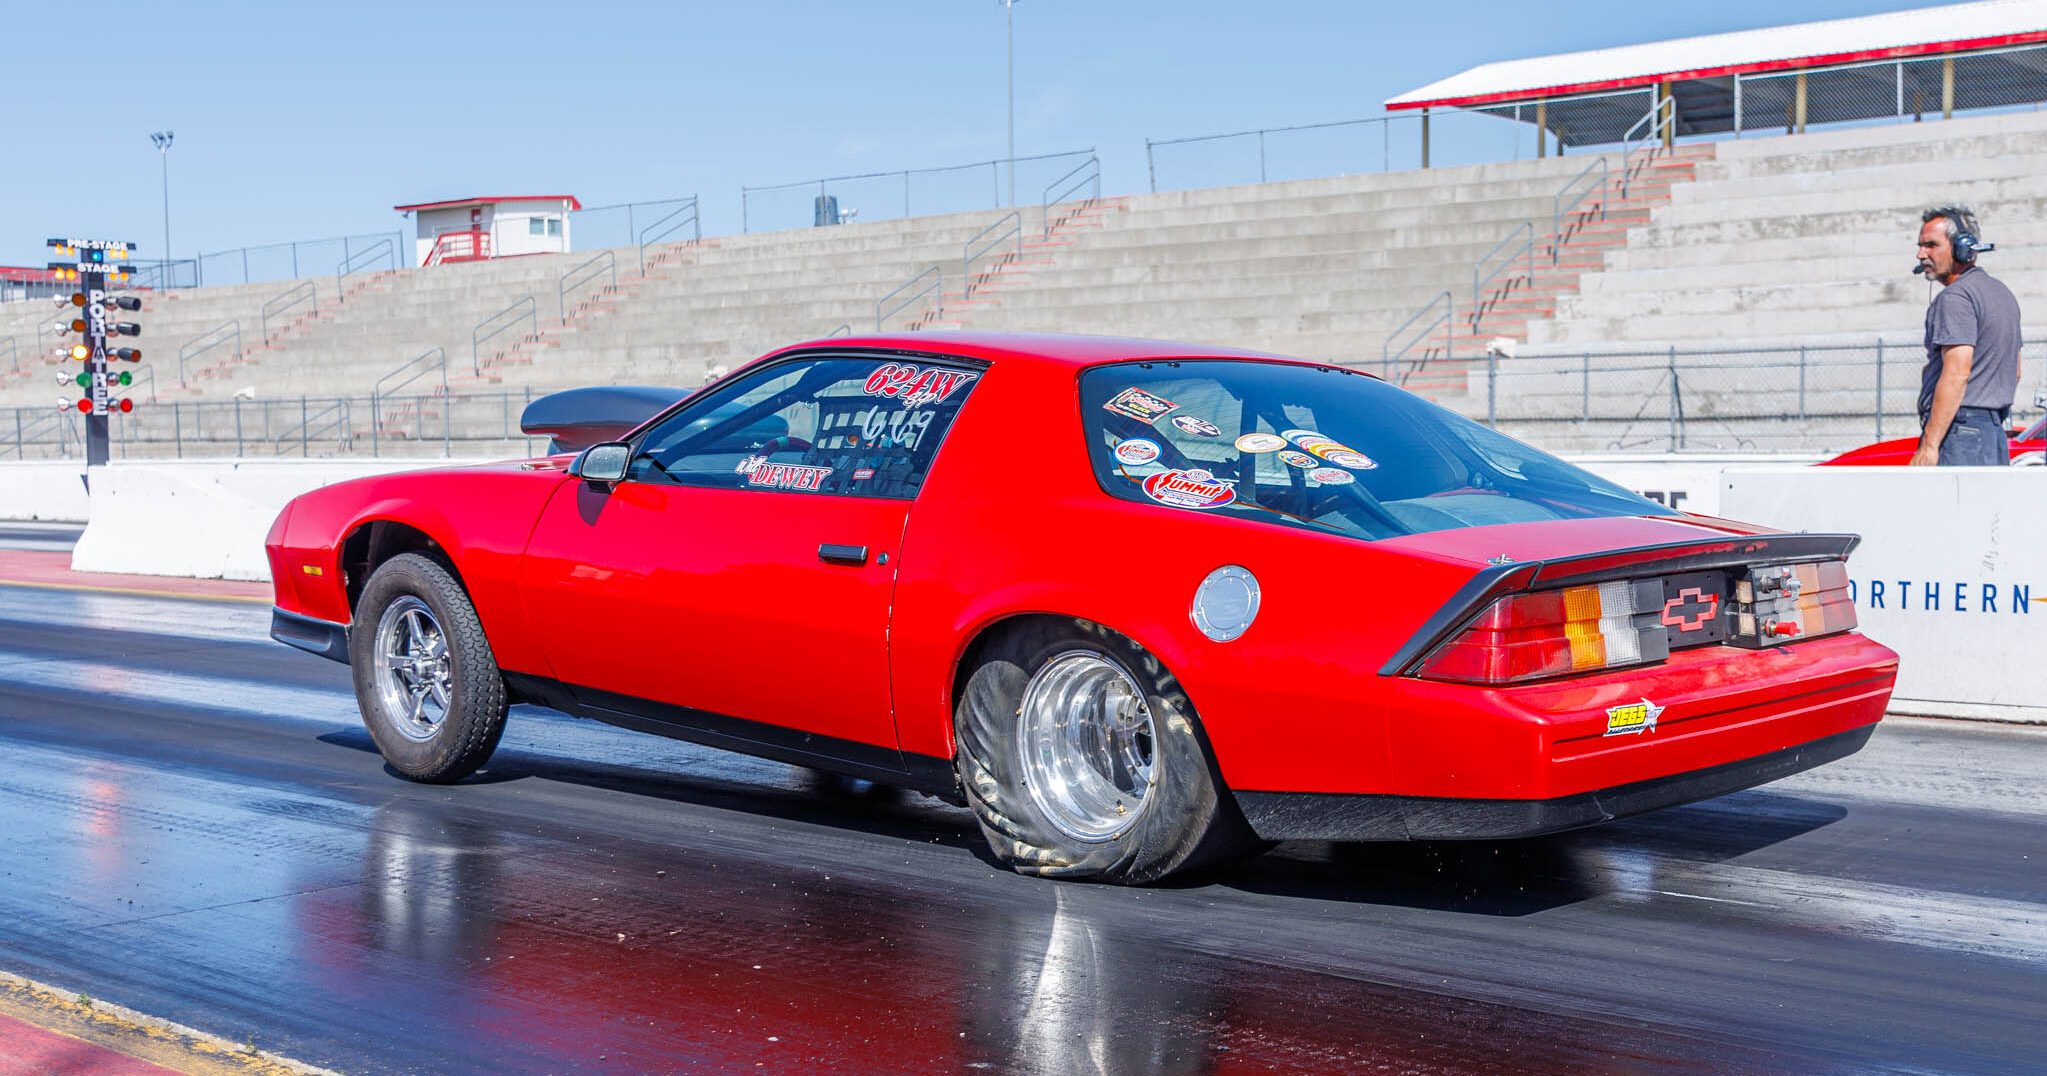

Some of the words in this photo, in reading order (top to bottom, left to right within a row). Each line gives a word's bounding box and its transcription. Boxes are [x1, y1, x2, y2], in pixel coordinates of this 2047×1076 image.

[67, 239, 128, 251] PRE-STAGE
[77, 262, 120, 274] STAGE
[89, 289, 109, 416] PORTATREE
[863, 362, 979, 405] 624W
[750, 462, 833, 490] DEWEY
[1155, 471, 1223, 498] SUMMIT
[1609, 704, 1648, 728] JEGS
